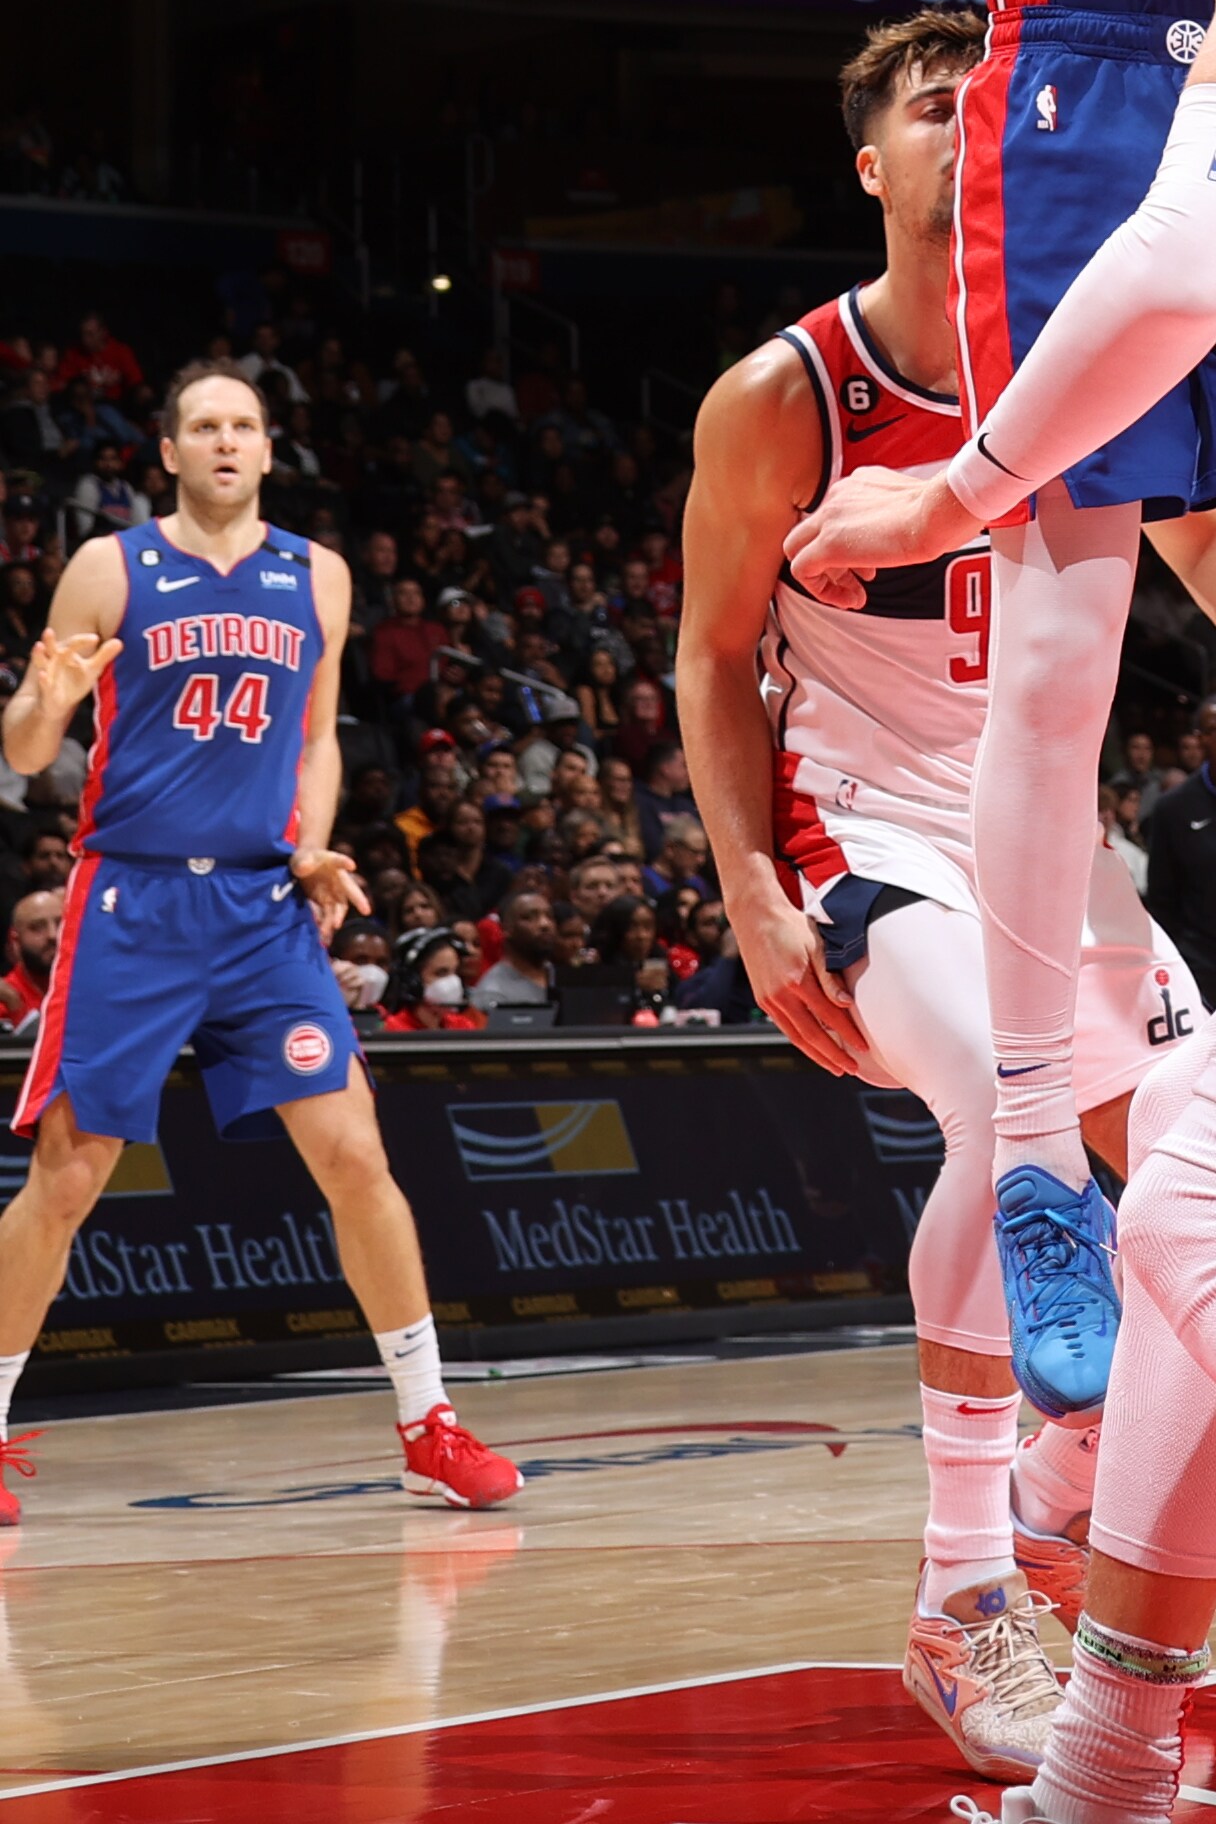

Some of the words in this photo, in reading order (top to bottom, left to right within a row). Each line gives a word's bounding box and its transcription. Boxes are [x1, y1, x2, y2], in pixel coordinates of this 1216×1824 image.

[847, 379, 871, 411] 6
[143, 612, 306, 672] DETROIT
[944, 553, 992, 684] 9
[173, 672, 272, 745] 44
[1147, 987, 1194, 1046] dc
[57, 1229, 192, 1301] dStar
[482, 1199, 660, 1272] MedStar
[658, 1188, 802, 1260] Health
